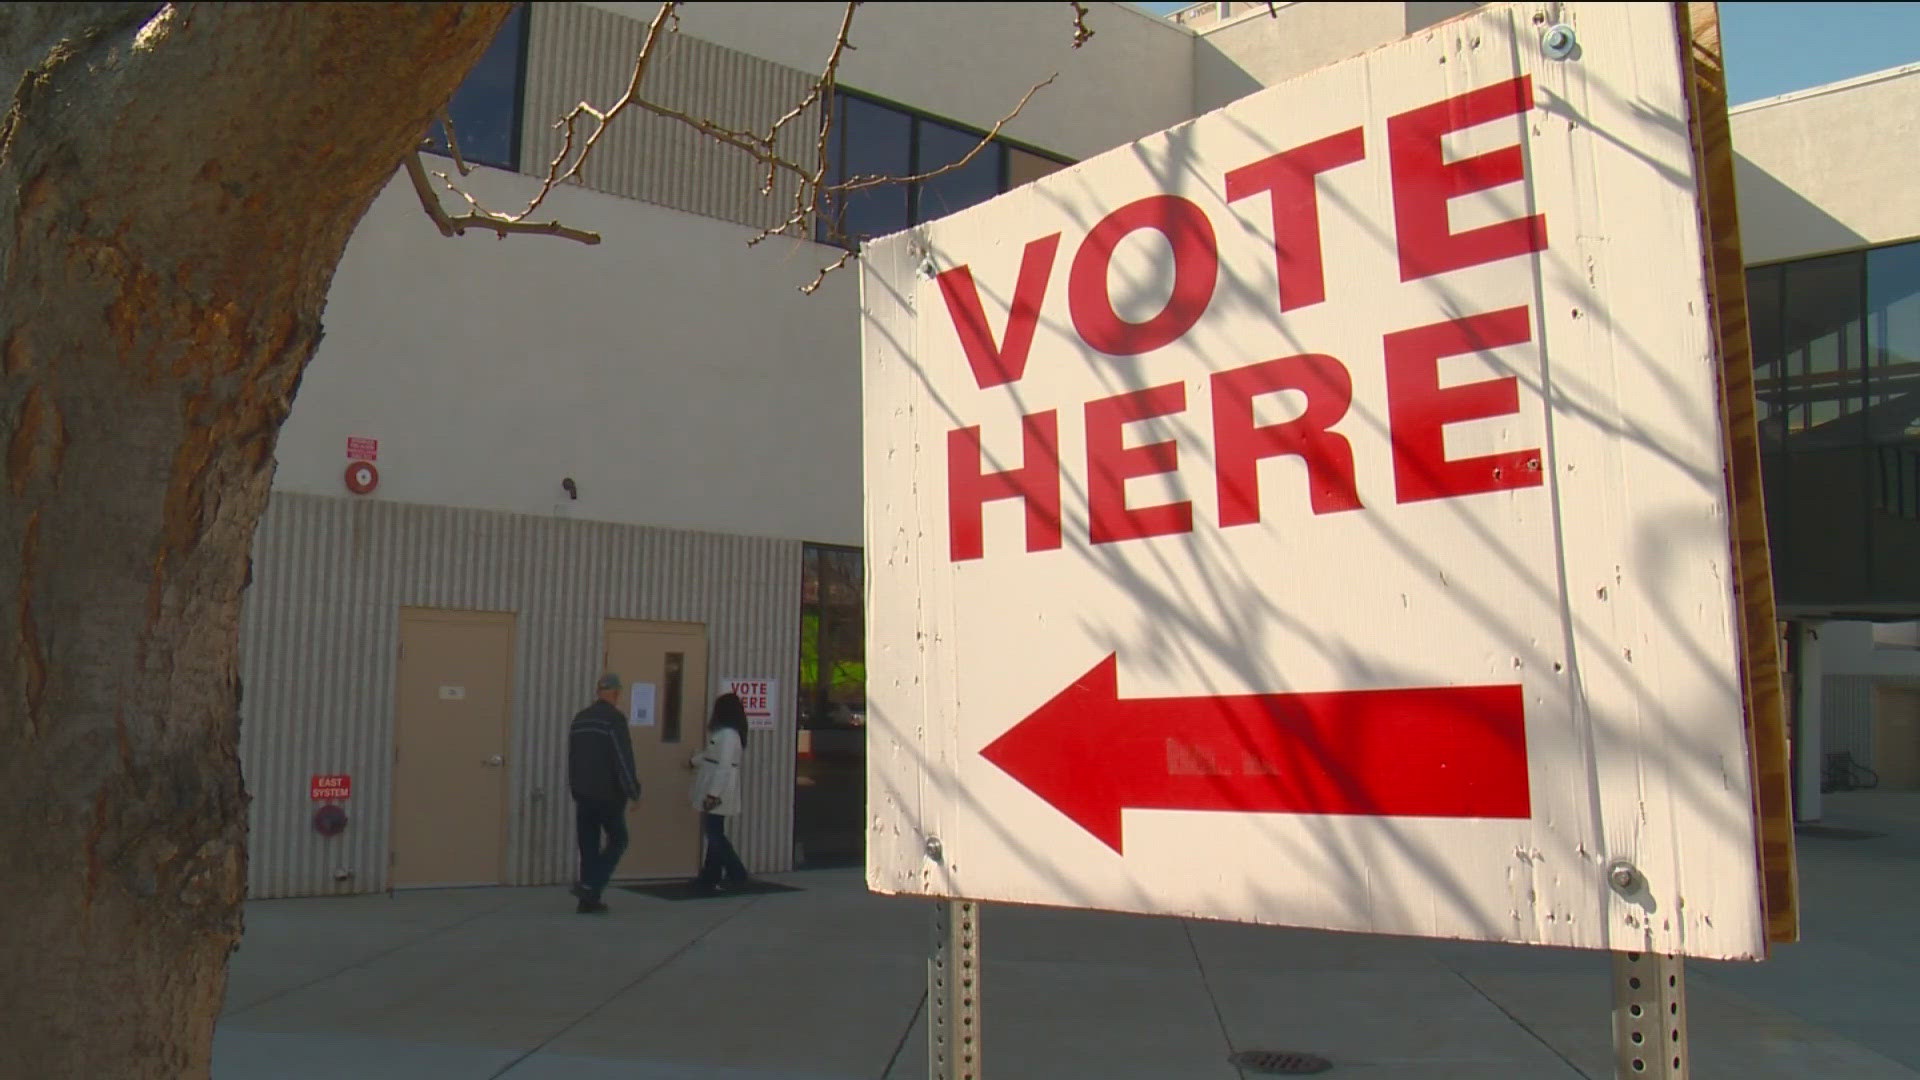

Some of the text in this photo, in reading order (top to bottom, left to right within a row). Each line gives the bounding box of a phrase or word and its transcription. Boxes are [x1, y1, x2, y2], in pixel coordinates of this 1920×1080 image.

[937, 74, 1548, 389] VOTE
[948, 305, 1543, 562] HERE
[731, 682, 767, 695] VOTE
[741, 697, 767, 709] ERE
[318, 778, 342, 787] EAST
[312, 788, 349, 798] SYSTEM
